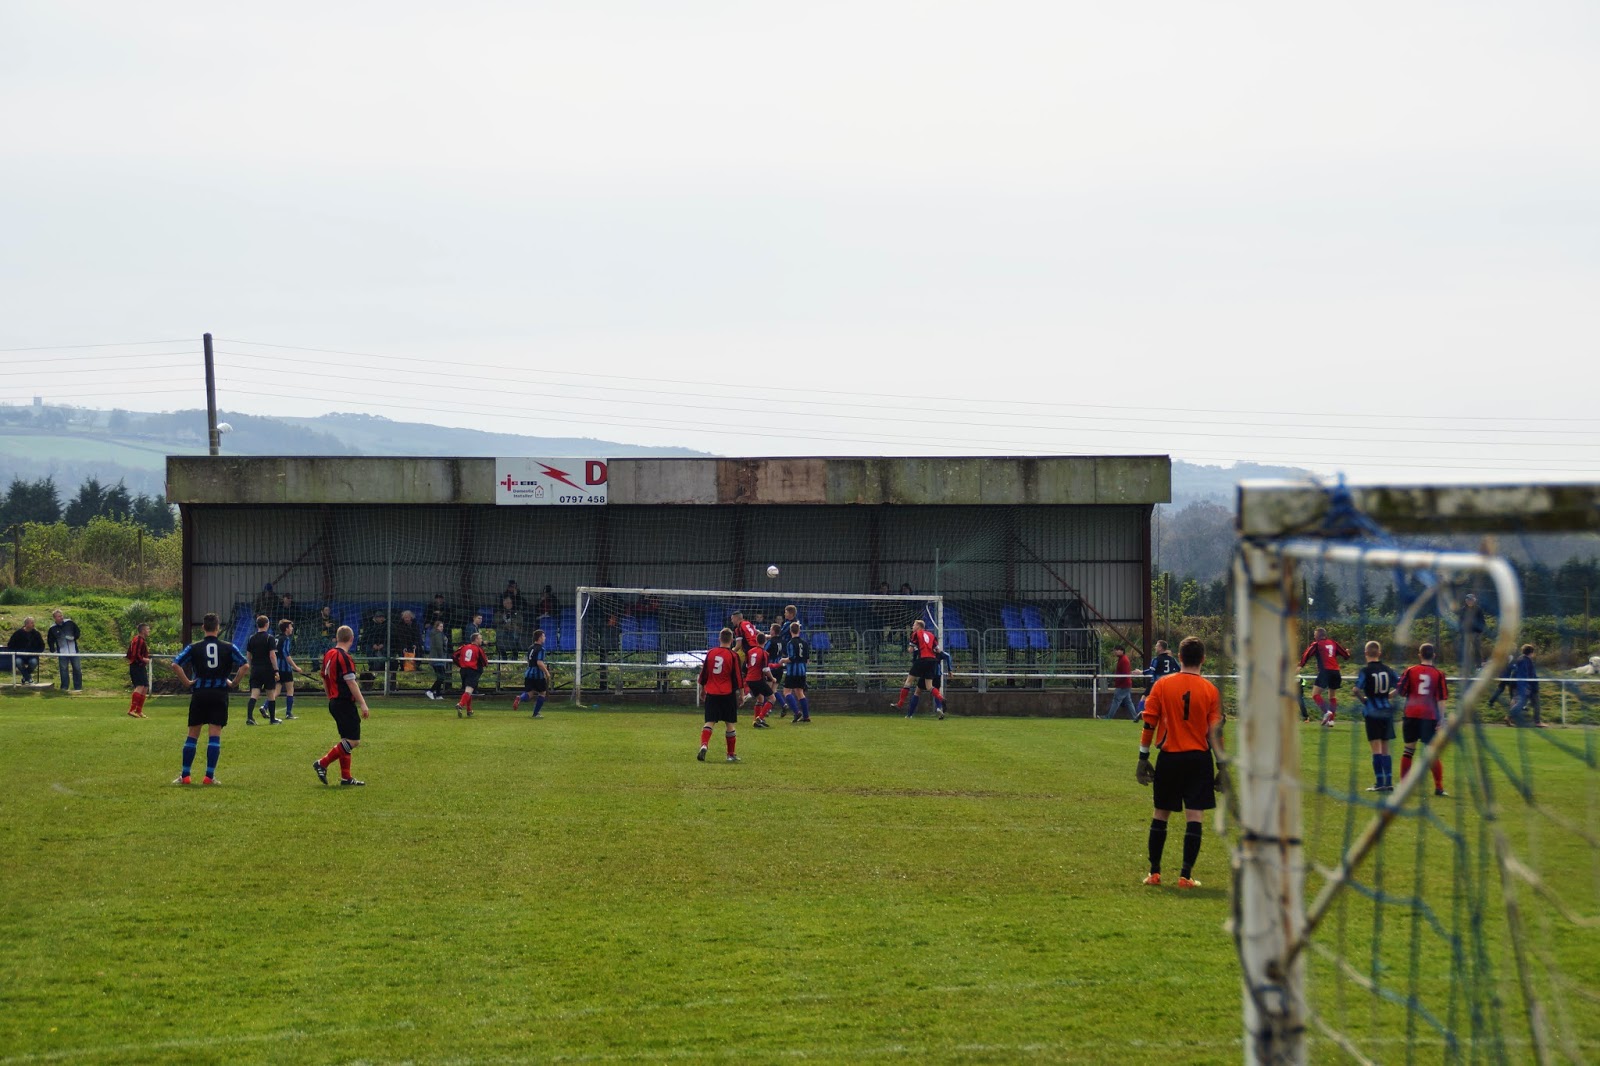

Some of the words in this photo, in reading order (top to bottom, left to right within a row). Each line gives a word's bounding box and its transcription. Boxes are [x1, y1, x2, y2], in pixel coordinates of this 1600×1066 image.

[585, 460, 608, 486] D
[559, 495, 583, 504] 0797
[587, 495, 606, 504] 458
[206, 643, 219, 669] 9
[464, 649, 473, 662] 9
[712, 655, 724, 675] 3
[1163, 659, 1170, 673] 3
[1371, 671, 1390, 694] 10
[1417, 673, 1431, 695] 2
[1182, 690, 1191, 721] 1
